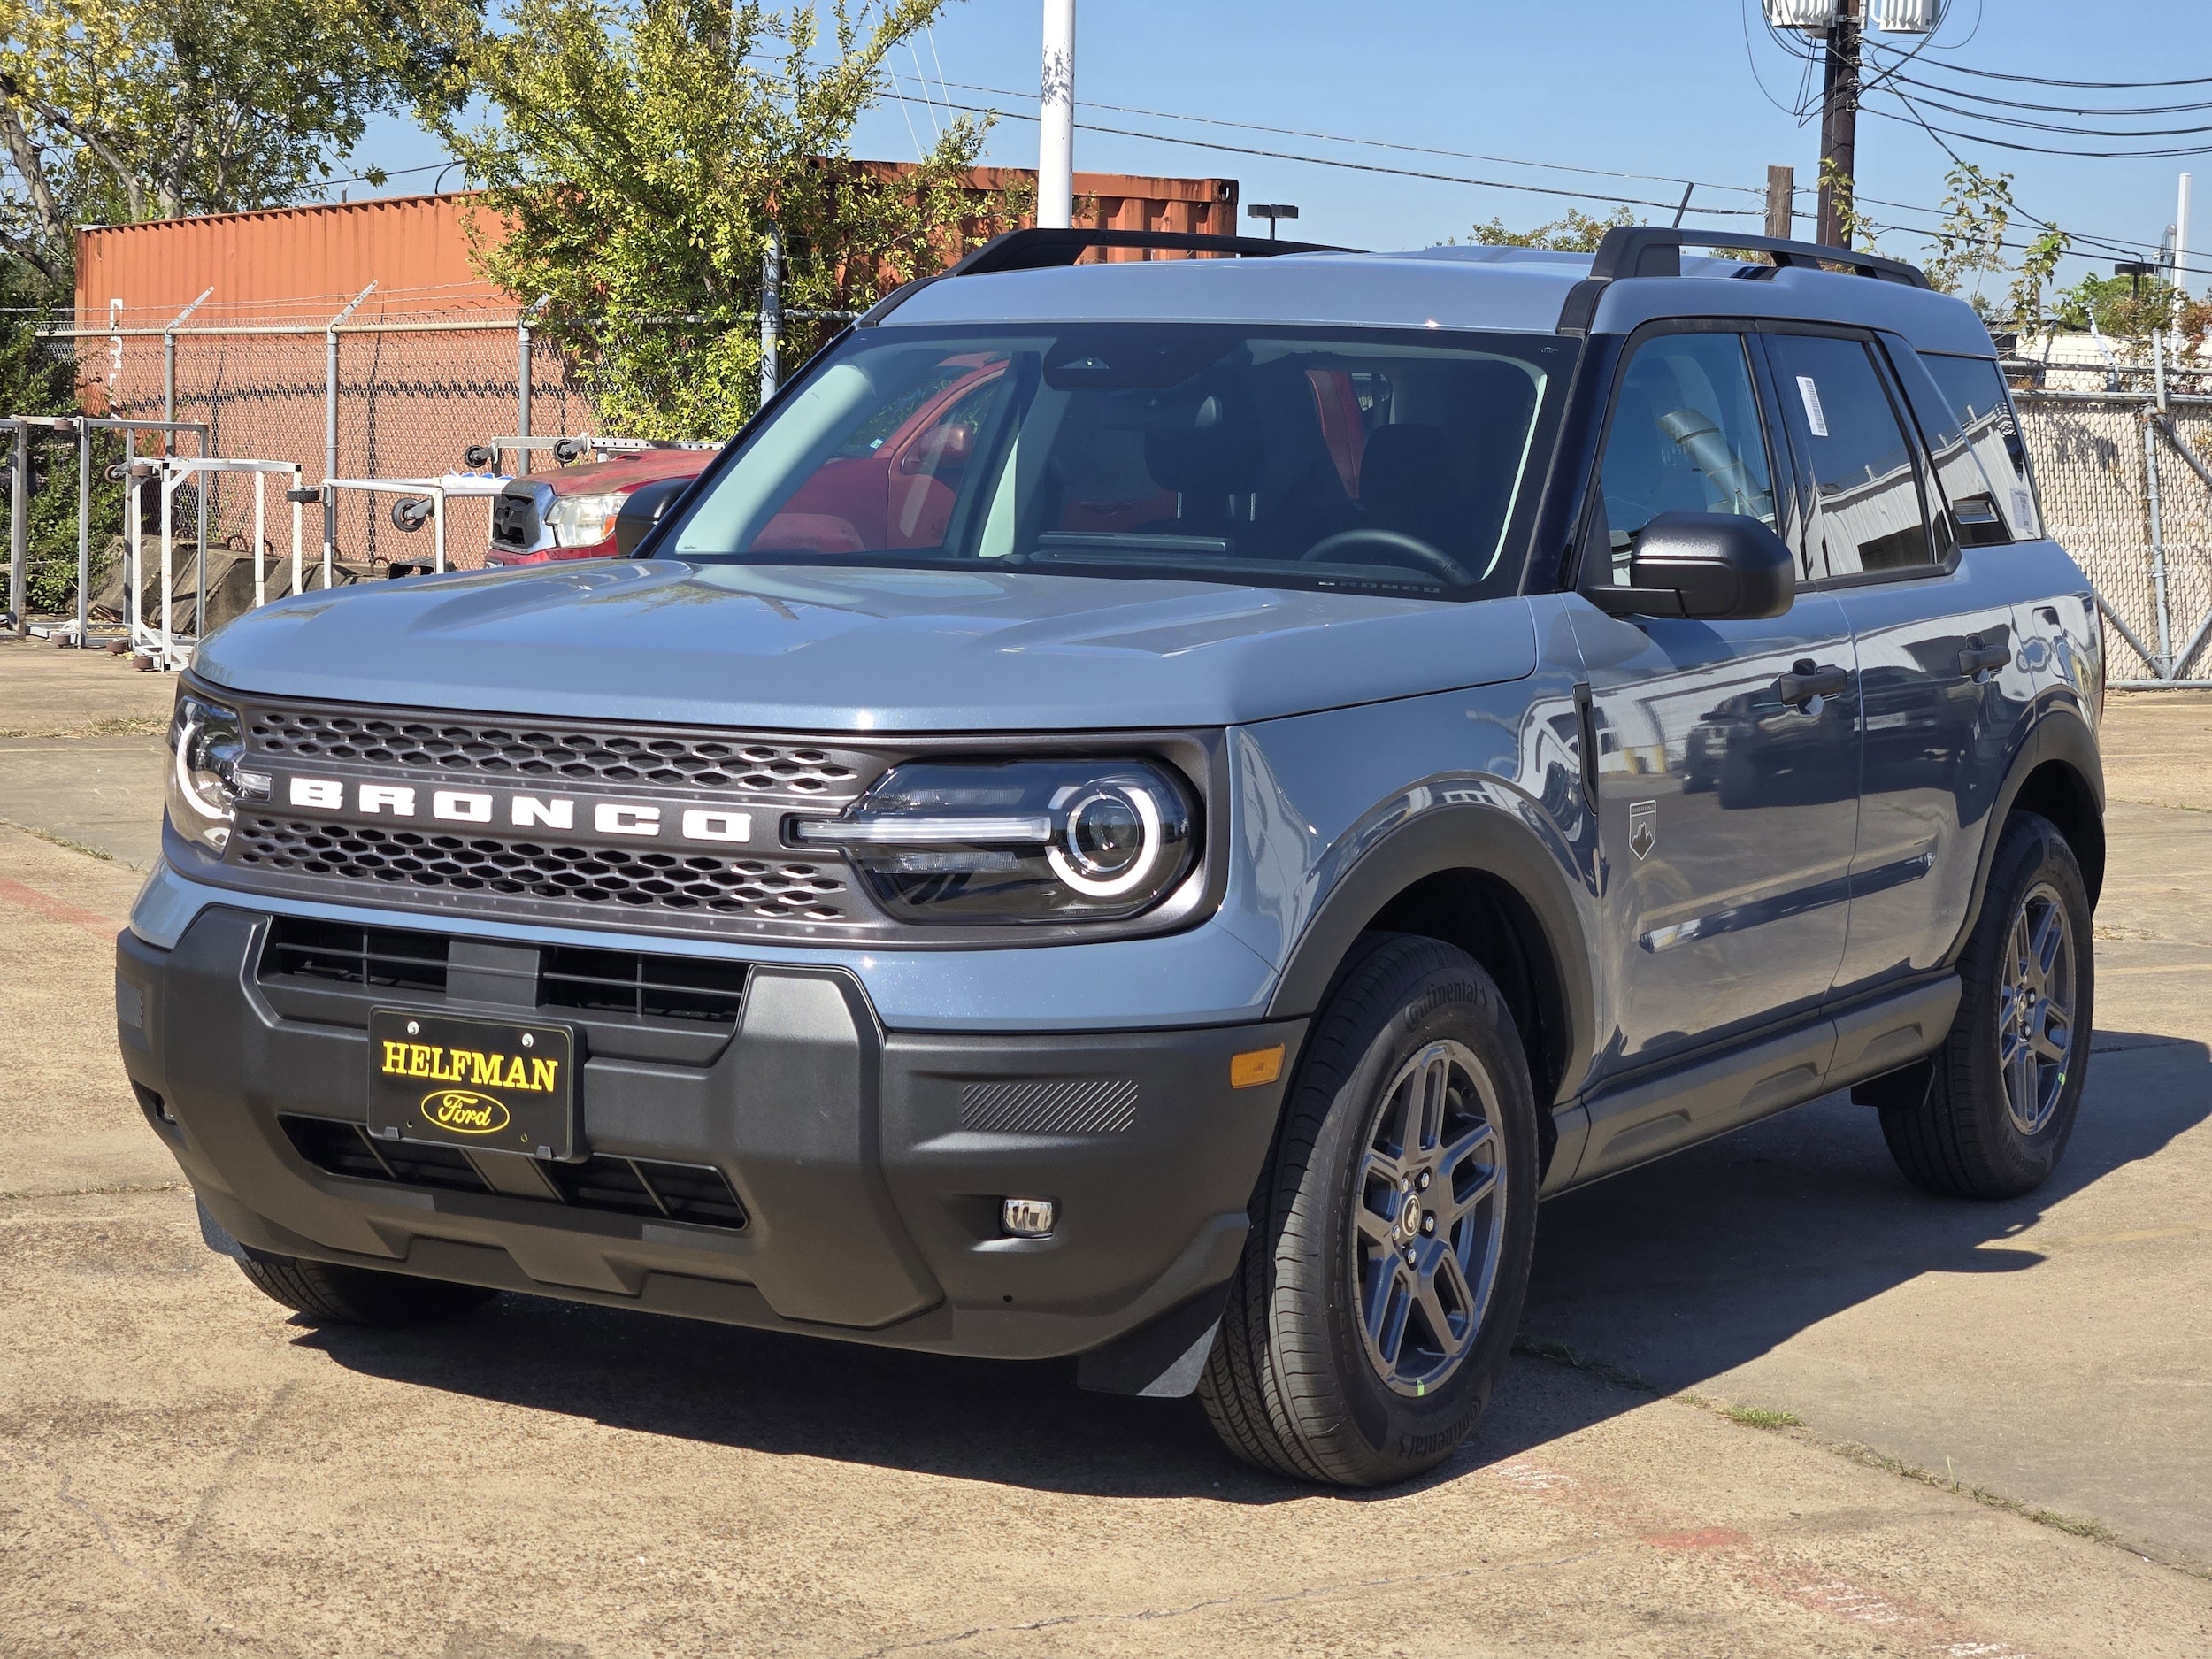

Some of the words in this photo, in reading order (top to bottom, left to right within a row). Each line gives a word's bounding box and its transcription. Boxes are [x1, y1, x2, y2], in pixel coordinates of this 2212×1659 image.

[289, 777, 752, 843] BRONCO
[1405, 979, 1478, 1033] Continental
[381, 1041, 559, 1092] HELFMAN
[437, 1094, 492, 1126] Ford
